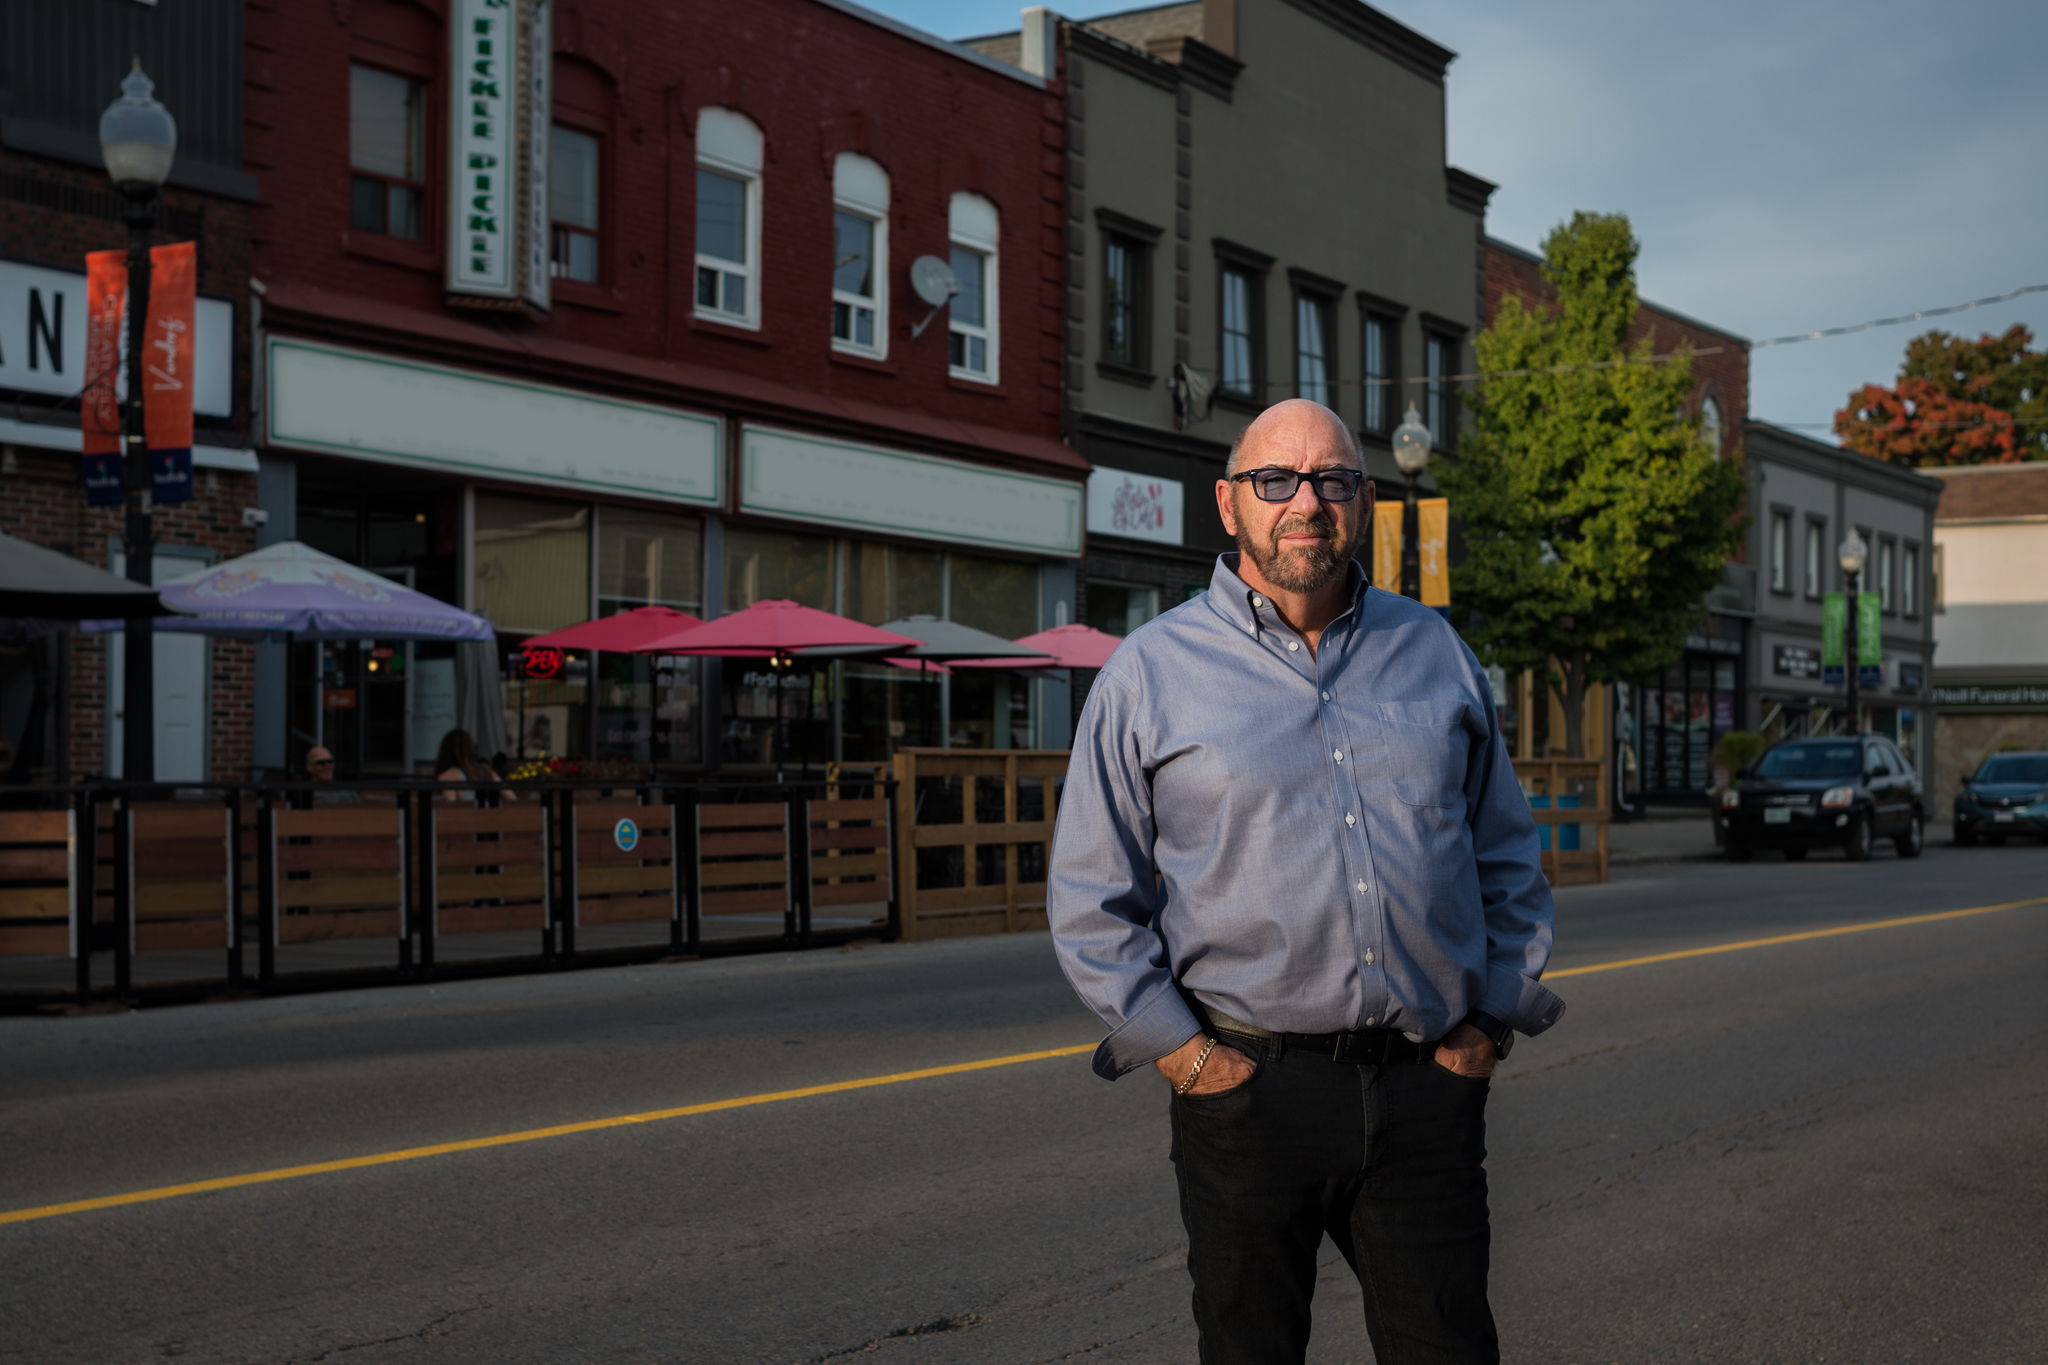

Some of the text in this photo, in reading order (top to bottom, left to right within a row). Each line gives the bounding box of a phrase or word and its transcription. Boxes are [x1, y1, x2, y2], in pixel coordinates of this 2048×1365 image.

[0, 286, 64, 374] N
[1969, 687, 2022, 704] Funeral
[2023, 687, 2048, 704] Ho
